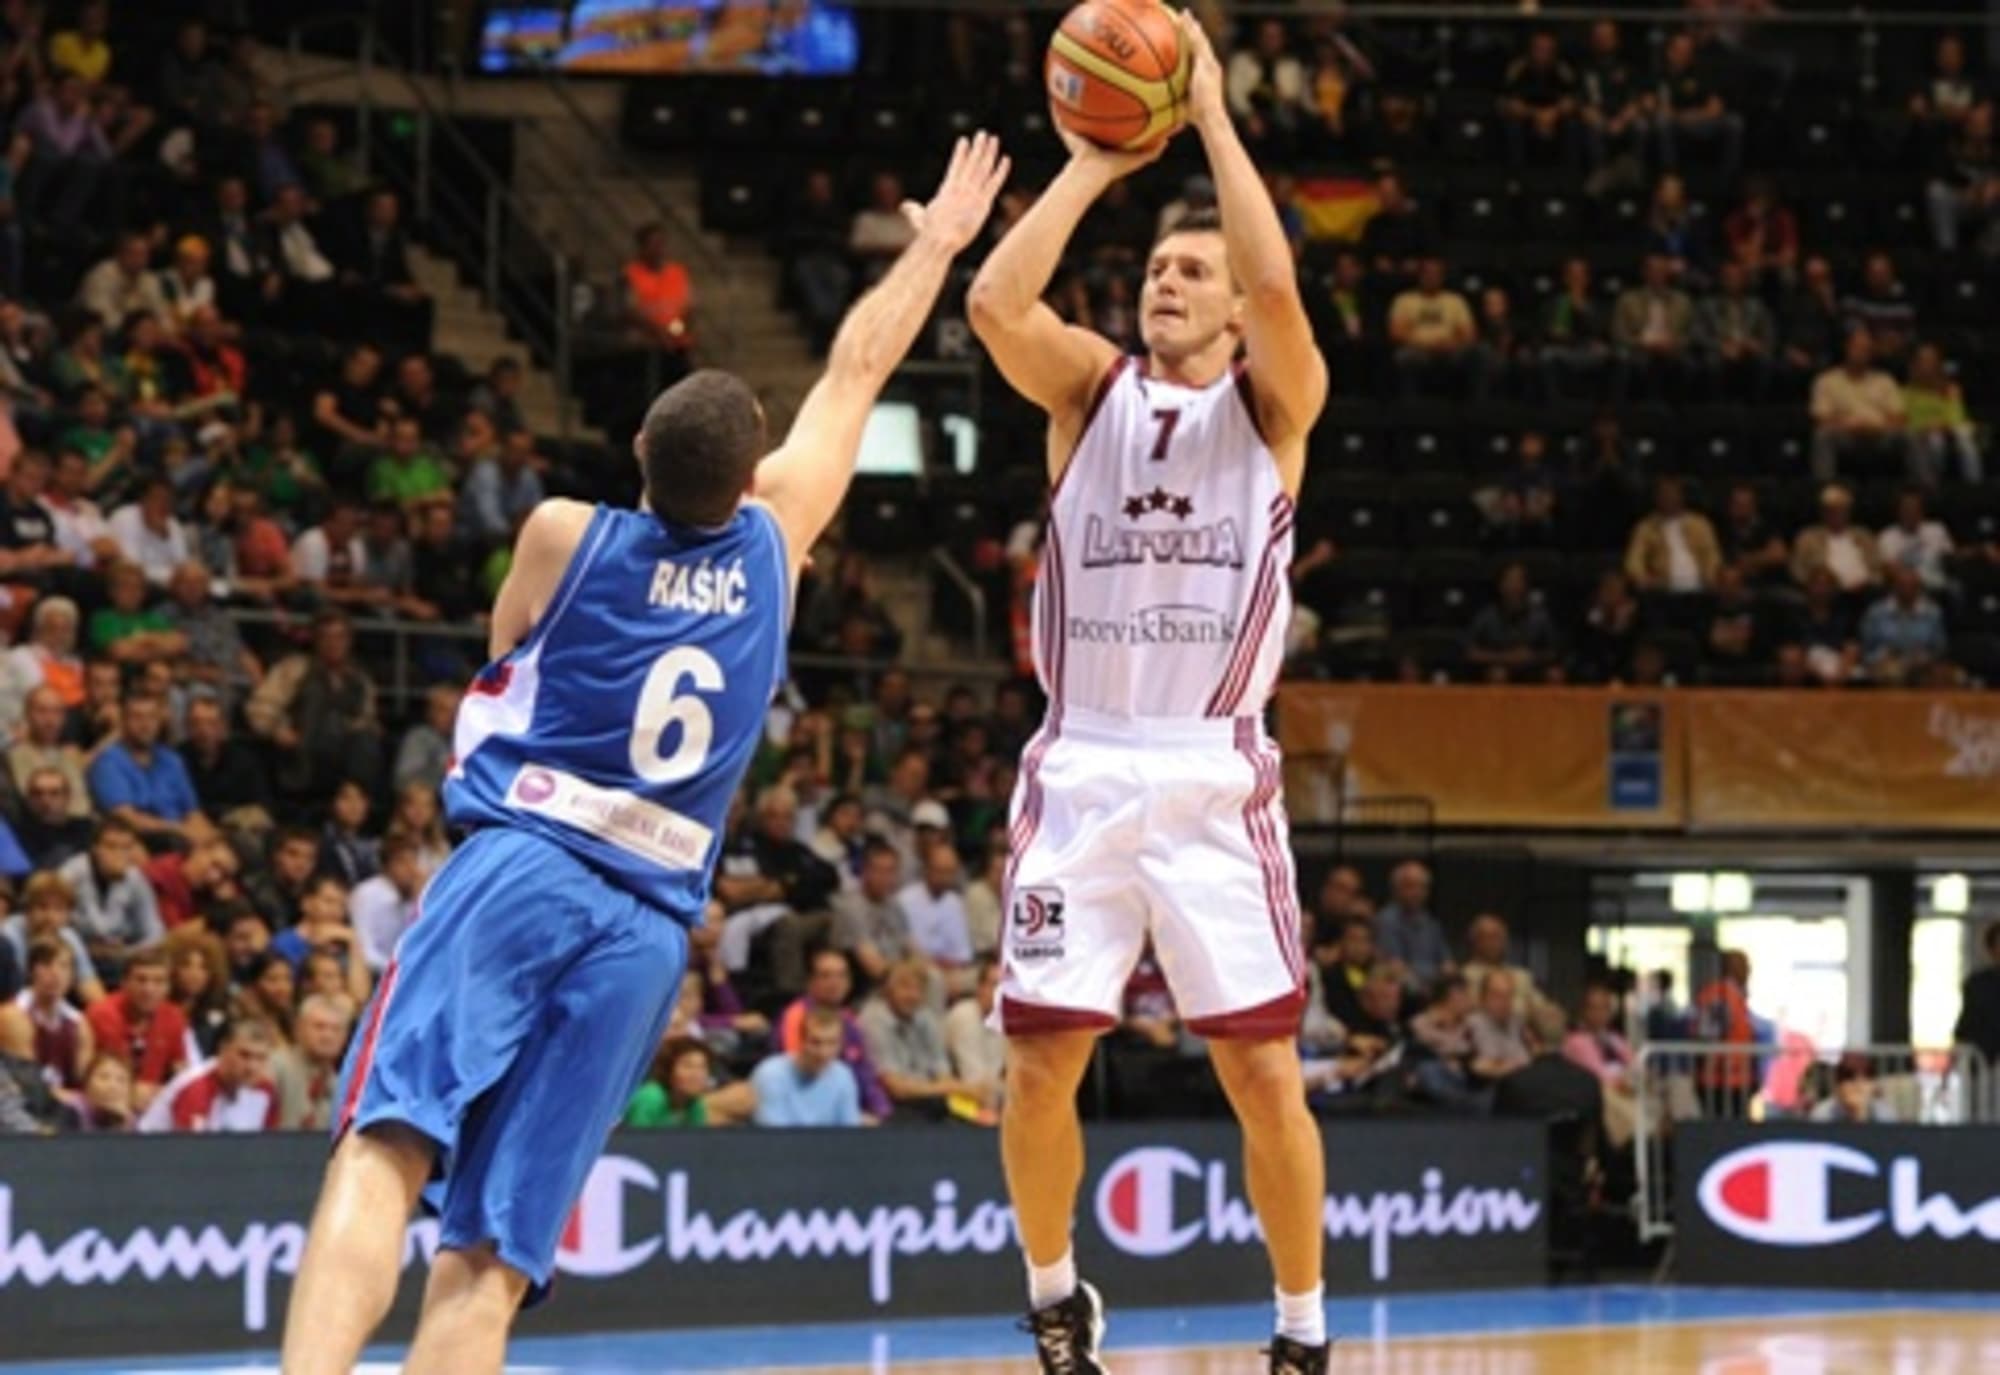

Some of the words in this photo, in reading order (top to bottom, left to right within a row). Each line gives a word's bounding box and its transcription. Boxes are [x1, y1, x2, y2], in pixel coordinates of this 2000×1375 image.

[1149, 408, 1180, 461] 7
[629, 645, 726, 785] 6
[555, 1155, 1024, 1303] Champio
[1095, 1146, 1540, 1281] Chmpion
